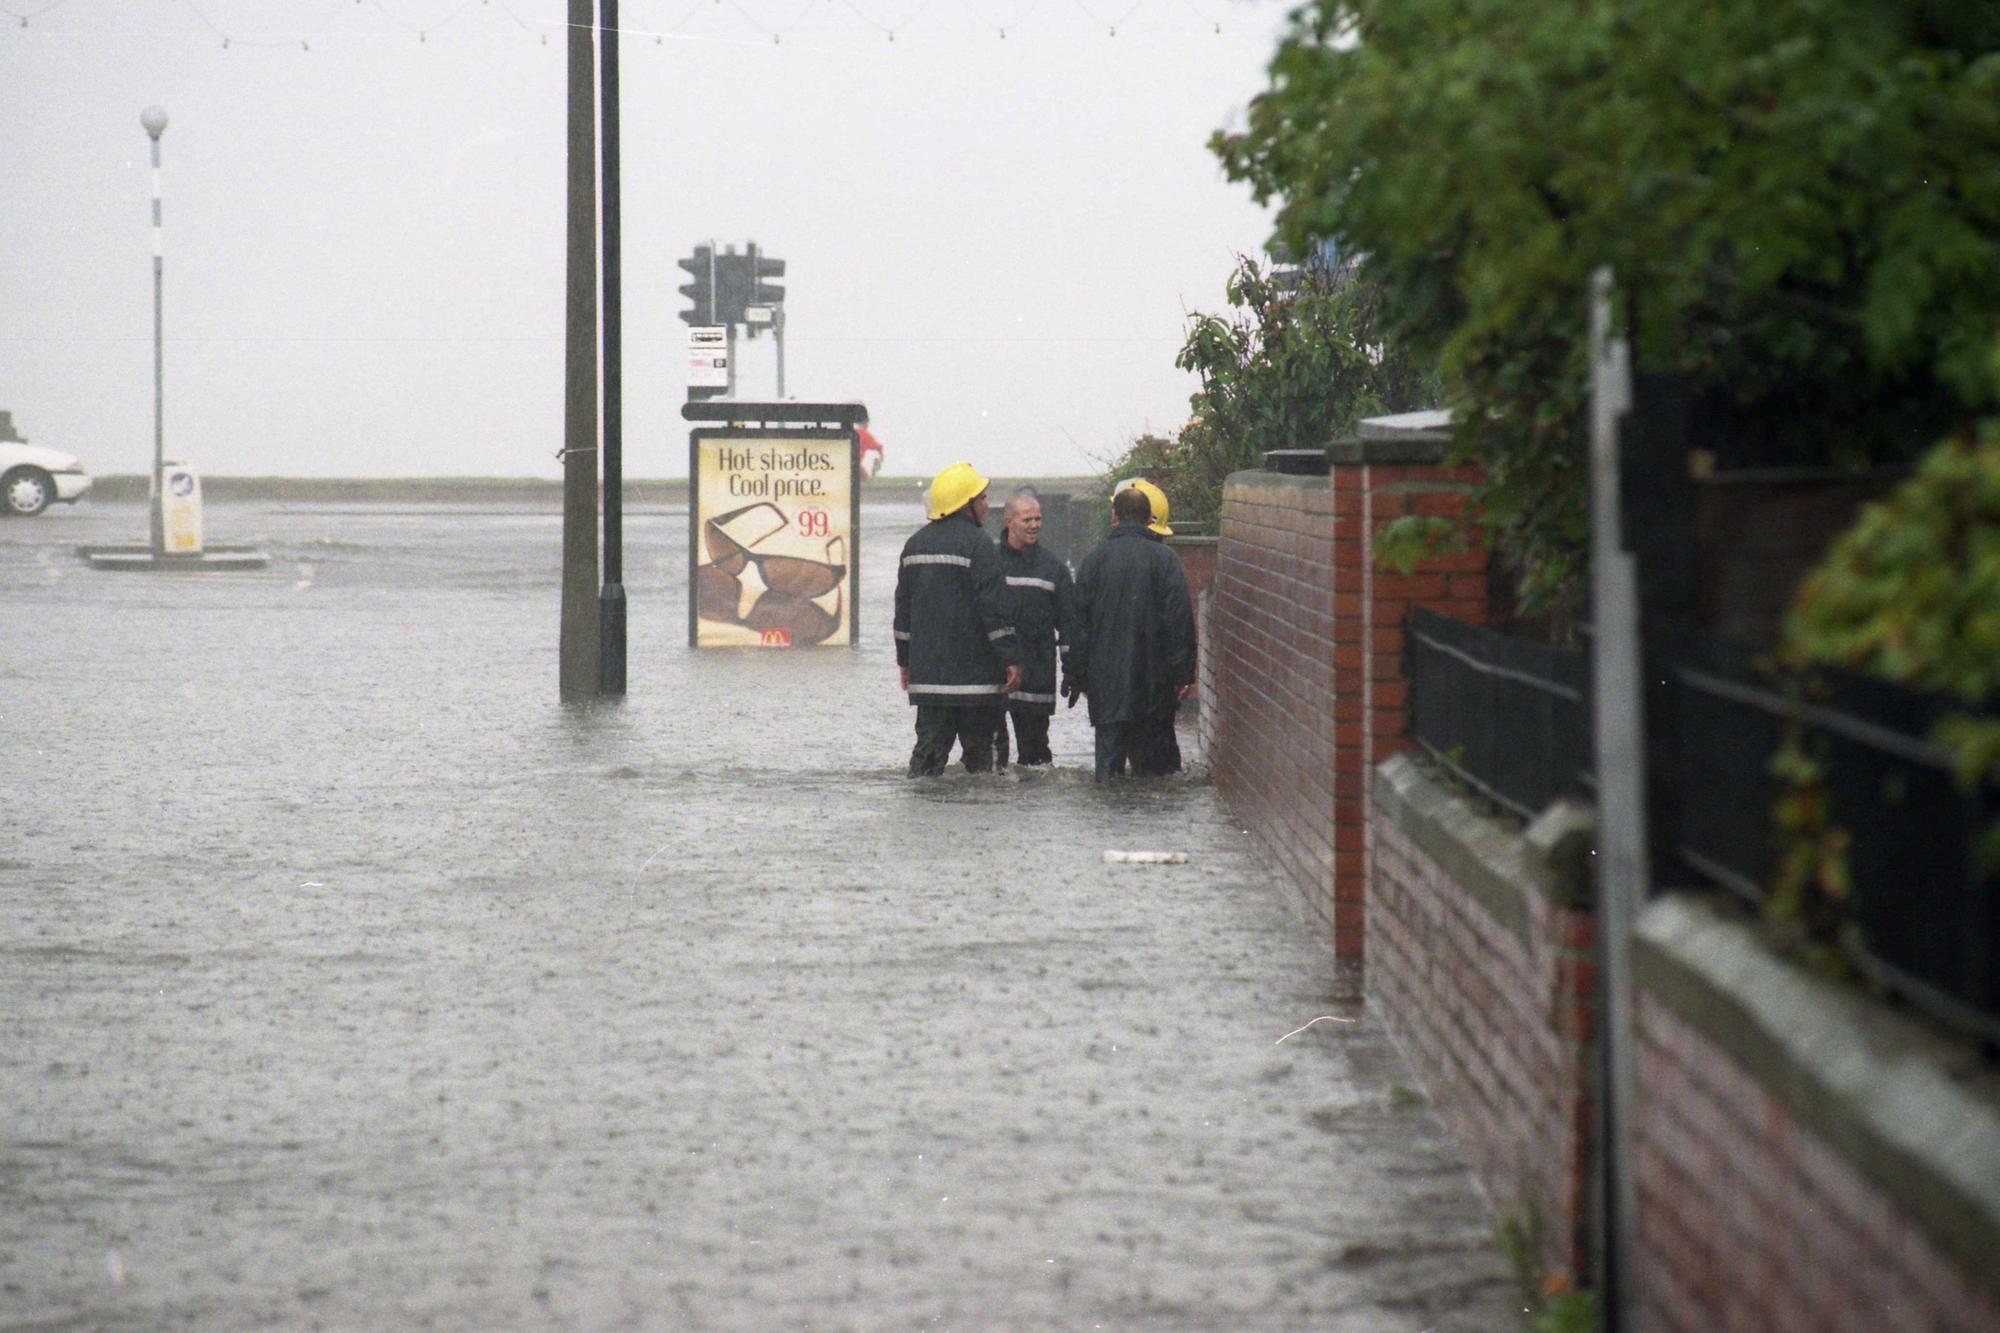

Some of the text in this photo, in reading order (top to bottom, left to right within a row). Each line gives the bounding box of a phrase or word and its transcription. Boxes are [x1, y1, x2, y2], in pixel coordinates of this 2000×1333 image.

[719, 448, 835, 471] Hot shades.
[730, 473, 827, 502] Cool price.
